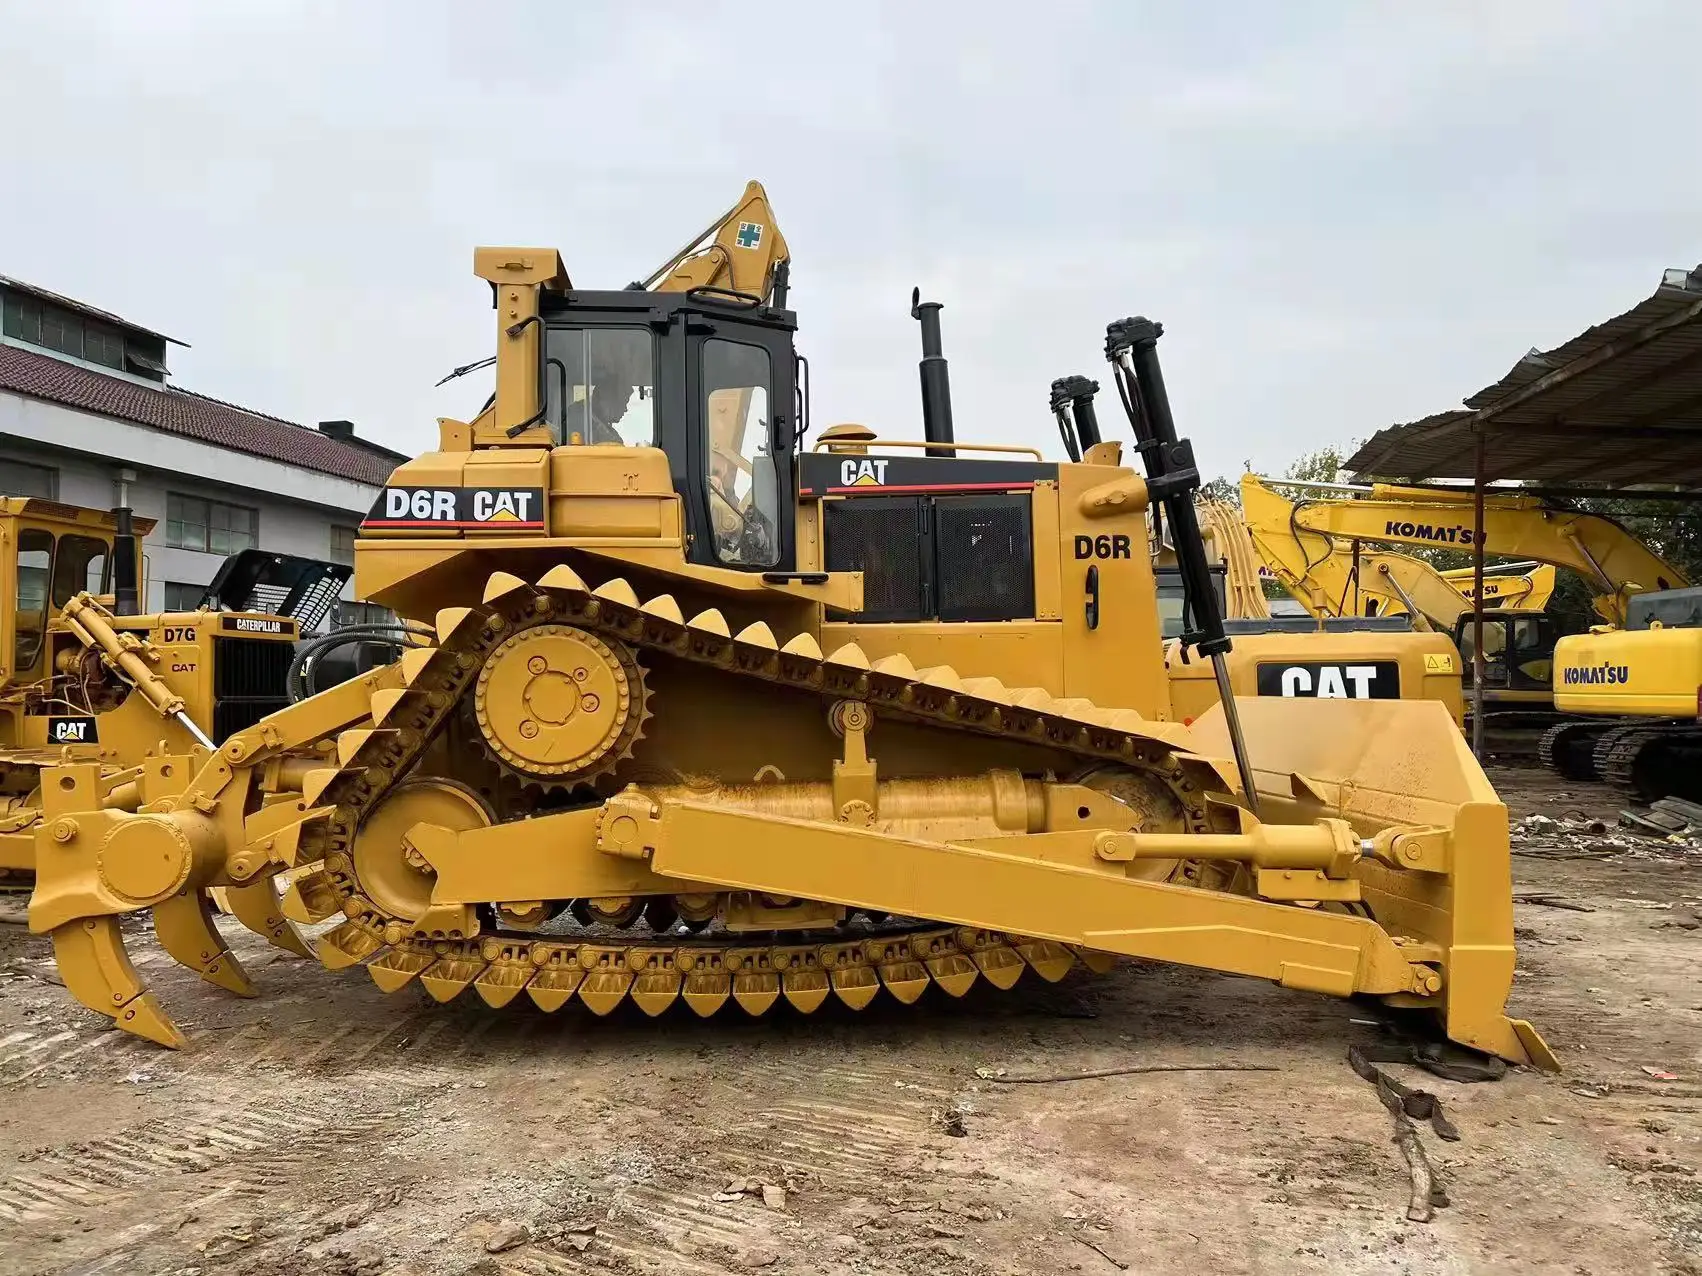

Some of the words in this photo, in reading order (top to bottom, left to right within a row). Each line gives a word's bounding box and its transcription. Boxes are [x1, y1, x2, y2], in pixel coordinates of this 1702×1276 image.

[840, 459, 889, 486] CAT
[385, 488, 457, 521] D6R
[473, 491, 533, 522] CAT
[1074, 534, 1131, 560] D6R
[164, 628, 196, 642] D7G
[236, 618, 281, 633] CATERPILLAR
[171, 663, 197, 673] CAT
[1564, 661, 1629, 684] KOMATSU
[1281, 665, 1377, 699] CAT
[56, 722, 87, 740] CAT
